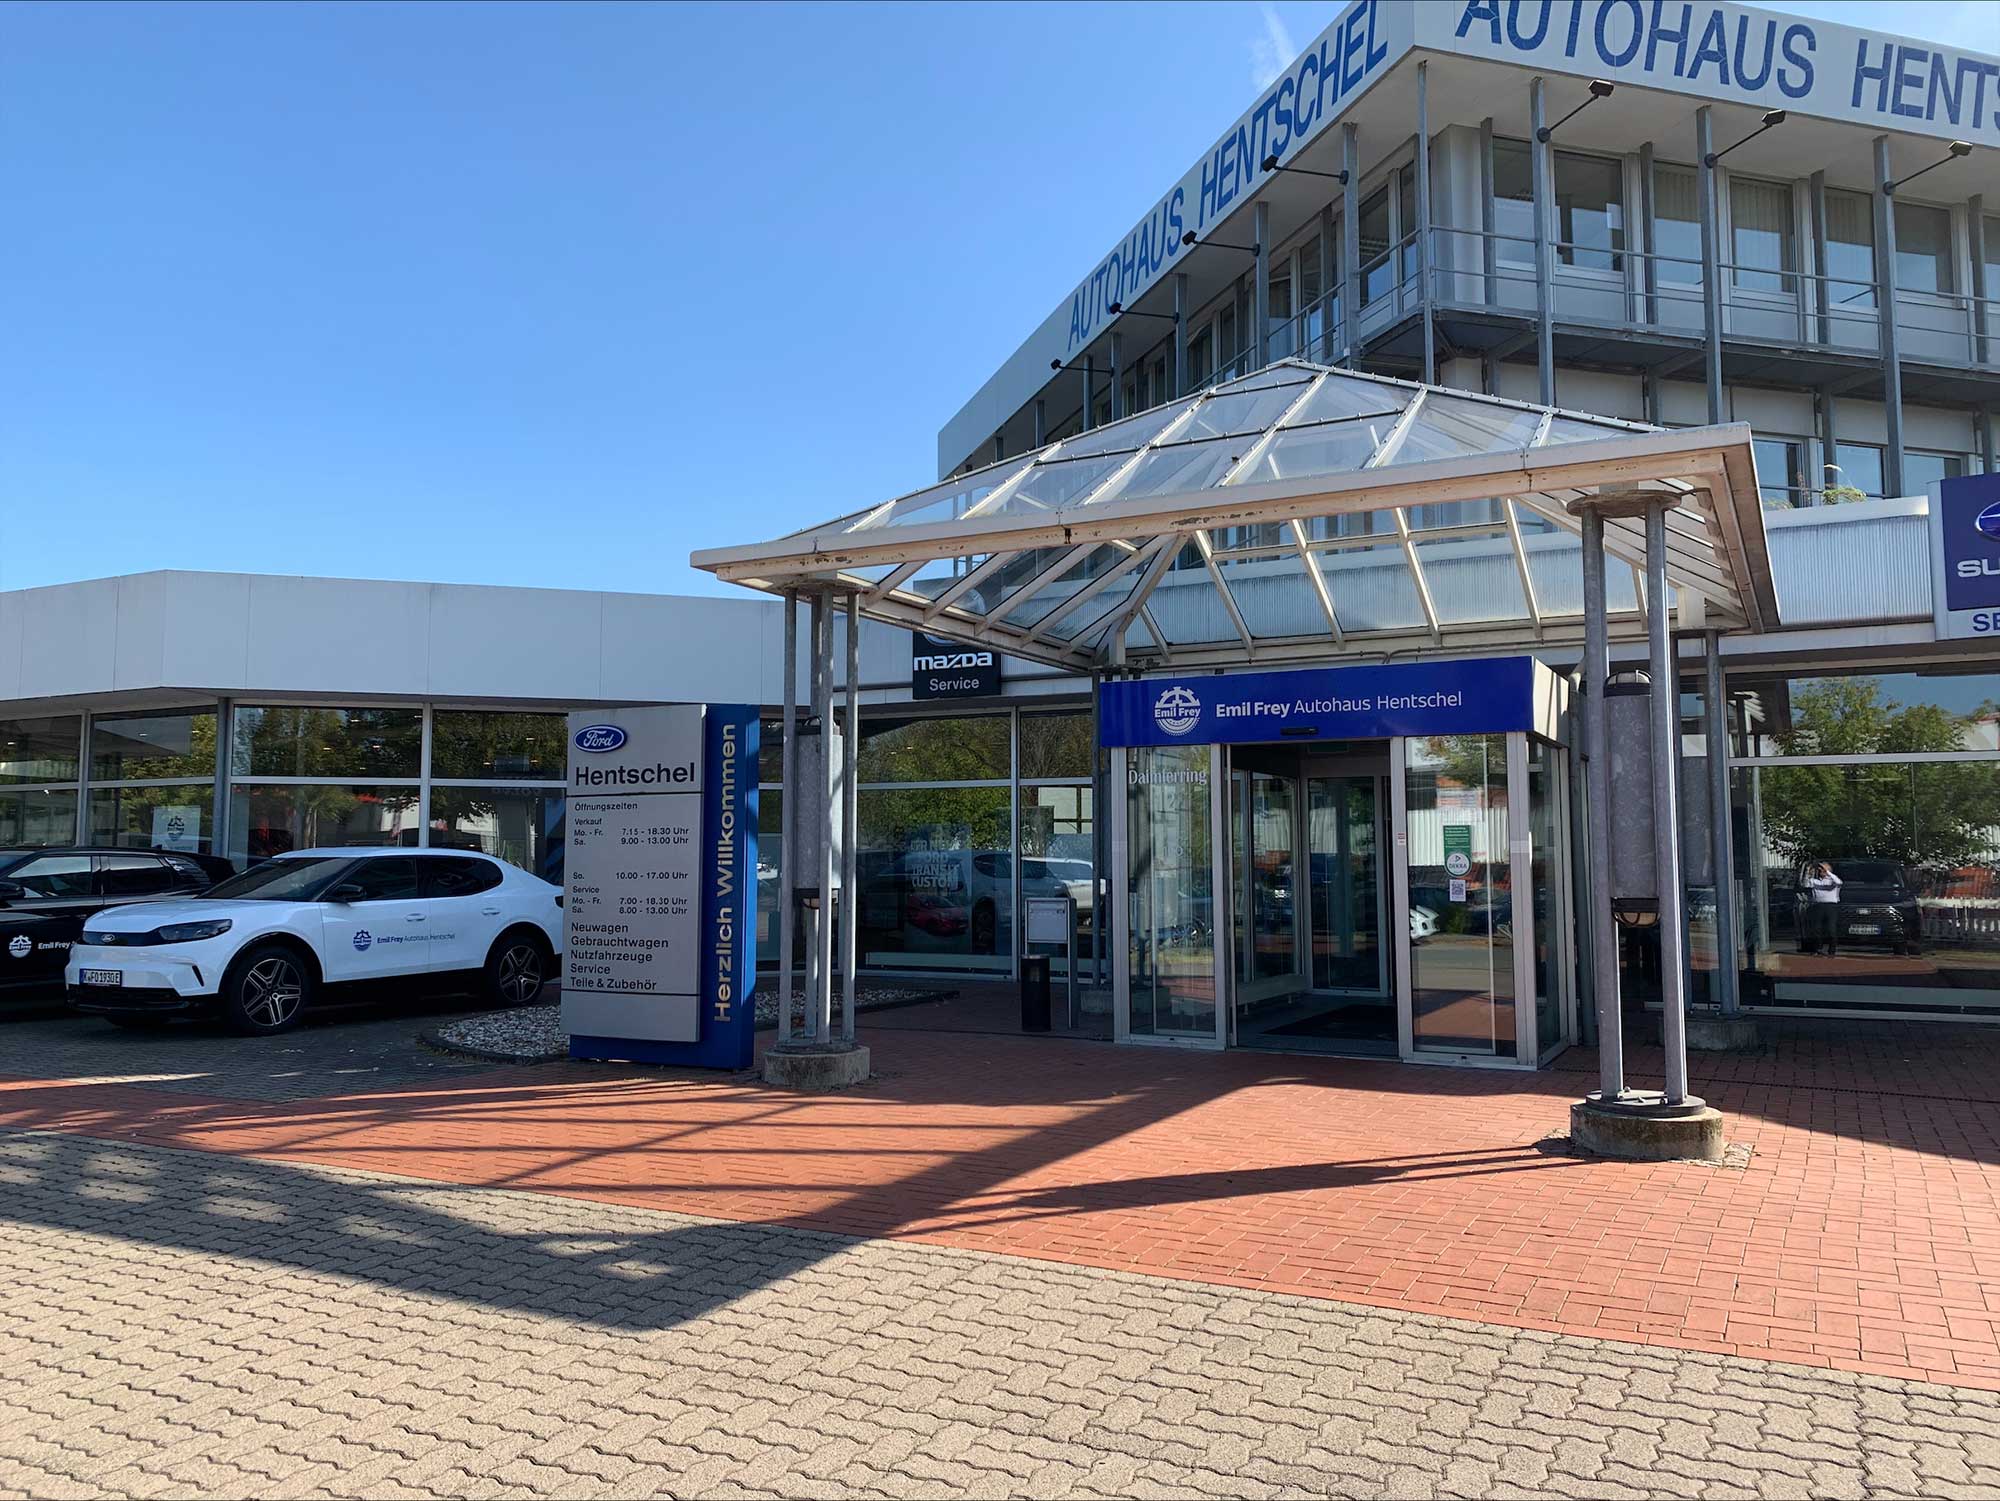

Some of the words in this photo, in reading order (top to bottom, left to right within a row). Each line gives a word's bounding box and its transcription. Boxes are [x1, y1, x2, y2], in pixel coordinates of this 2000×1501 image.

[1852, 39, 2000, 132] HENT
[1067, 187, 1185, 351] AUTOHAUS
[1198, 0, 1388, 229] HENTSCHEL
[929, 677, 980, 691] Service
[1216, 701, 1251, 718] Emil
[1254, 699, 1290, 719] Frey
[1294, 697, 1371, 714] Autohaus
[1377, 691, 1463, 710] Hentschel
[1154, 708, 1177, 718] Emil
[1178, 707, 1201, 718] Frey
[583, 729, 613, 747] Ford
[575, 762, 695, 786] Hentschel
[575, 802, 638, 812] Öffnungszeiten
[716, 724, 736, 897] Willkommen
[574, 818, 602, 826] Verkauf
[574, 829, 587, 837] Mo.
[594, 829, 604, 837] Fr.
[622, 828, 639, 836] 7.15
[673, 827, 689, 835] Uhr
[574, 838, 586, 846] Sa.
[621, 837, 639, 845] 9.00
[648, 837, 671, 845] 13.00
[573, 872, 585, 880] So.
[616, 872, 638, 880] 10.00
[646, 872, 669, 880] 17.00
[672, 872, 688, 880] Uhr
[572, 885, 600, 894] Service
[572, 897, 585, 905] Mo.
[592, 897, 602, 905] Fr.
[619, 897, 638, 905] 7.00
[646, 897, 669, 905] 18.30
[671, 897, 688, 905] Uhr
[571, 906, 584, 914] Sa.
[646, 907, 669, 915] 13.00
[671, 907, 688, 915] Uhr
[571, 922, 629, 935] Neuwagen
[38, 942, 54, 950] Emil
[55, 941, 71, 949] Frey
[571, 936, 669, 949] Gebrauchtwagen
[570, 949, 653, 963] Nutzfahrzeuge
[570, 963, 611, 975] Service
[714, 907, 733, 1022] Herzlich
[570, 977, 594, 988] Teile
[596, 978, 605, 988] &
[607, 979, 657, 990] Zubehör
